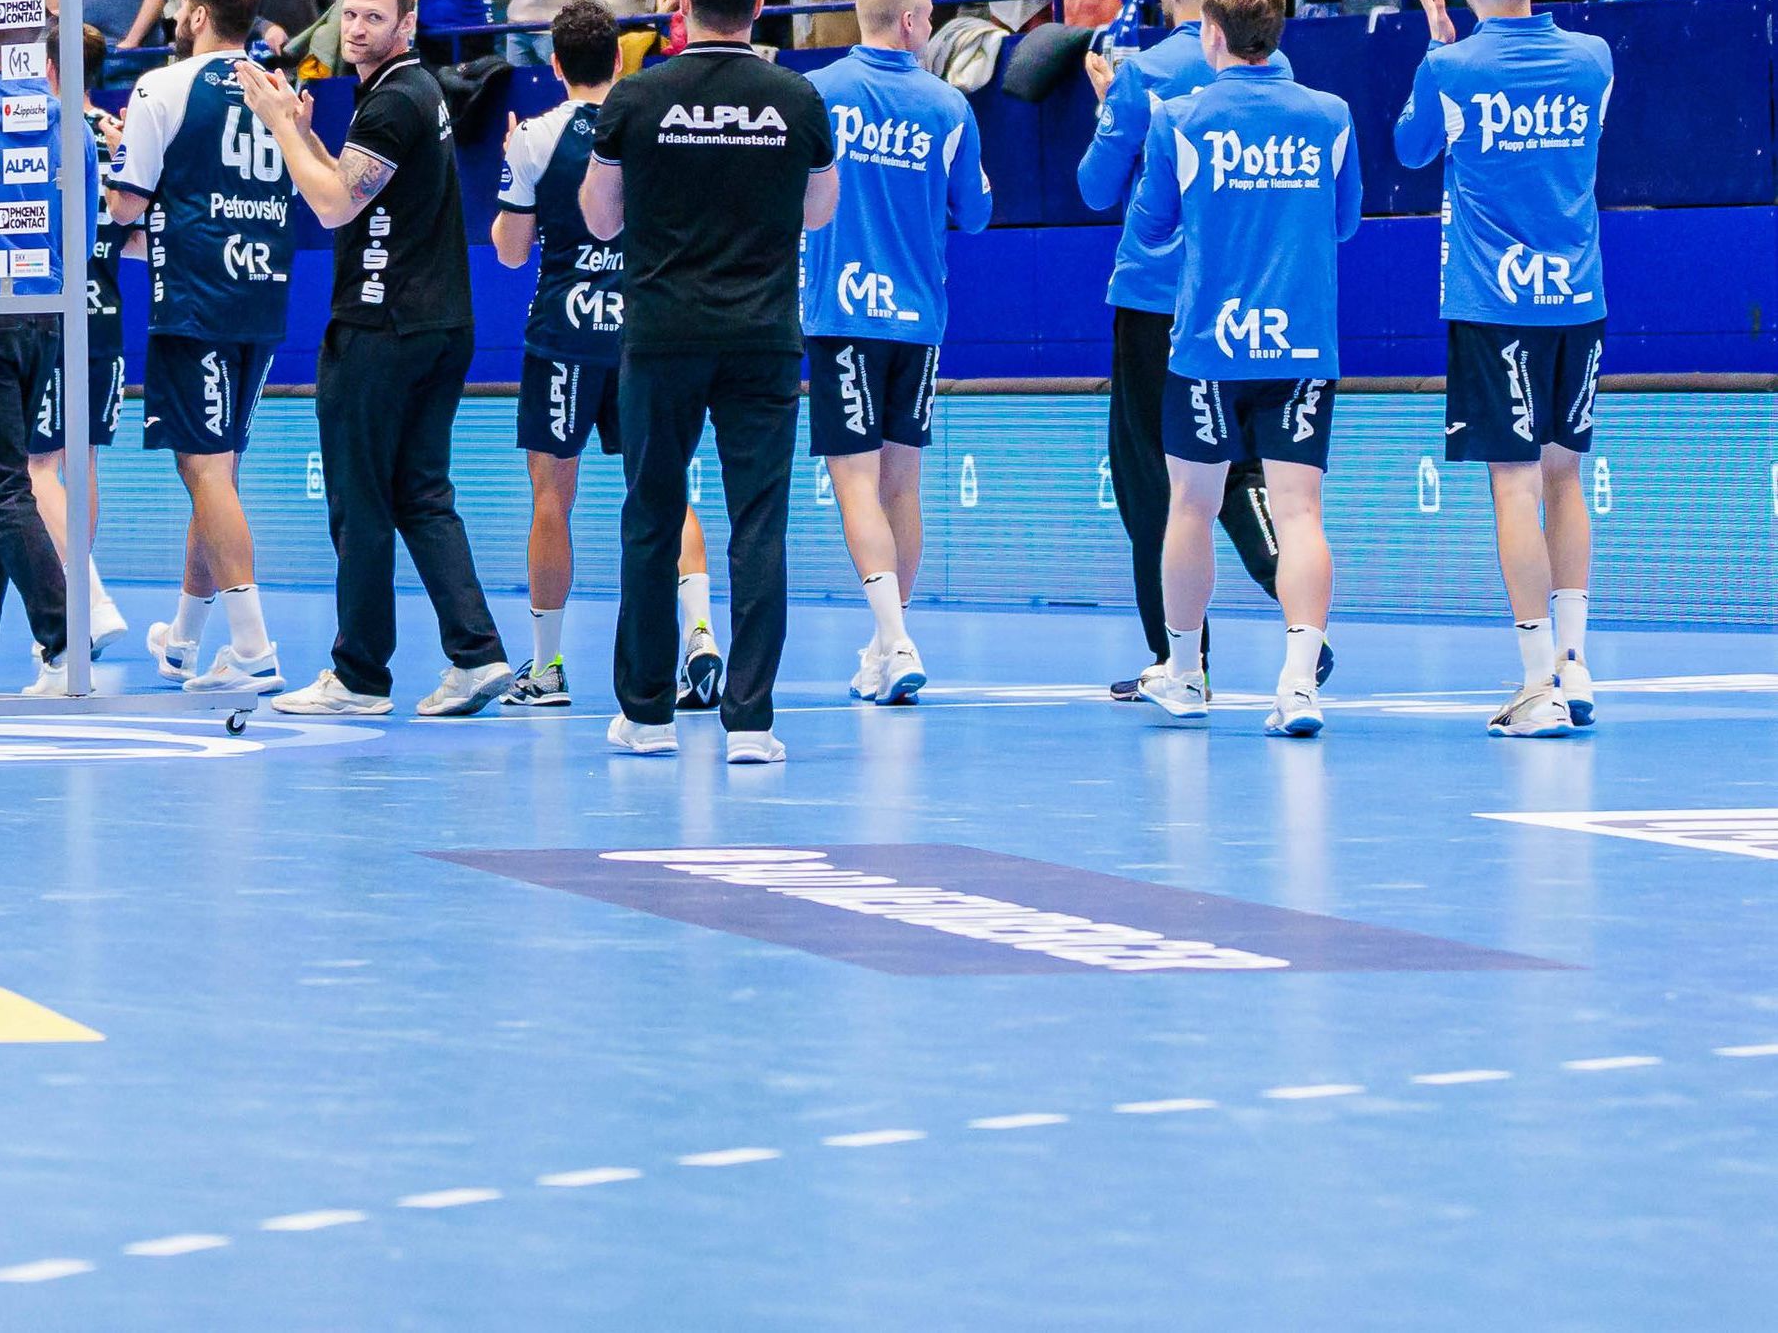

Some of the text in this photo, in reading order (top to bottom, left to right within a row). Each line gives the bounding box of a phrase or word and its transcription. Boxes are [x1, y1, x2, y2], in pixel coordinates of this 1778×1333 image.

[6, 11, 42, 24] CONTACT
[12, 103, 46, 118] Lippische
[660, 104, 788, 131] ALPLA
[1470, 91, 1590, 154] Pott's
[658, 133, 787, 146] #daskannkunststoff
[831, 104, 933, 161] Pott's
[5, 158, 46, 174] ALPLA
[1203, 129, 1321, 193] Pott's
[9, 217, 45, 229] CONTACT
[210, 192, 288, 227] Petrovský
[574, 244, 624, 272] Zehn
[201, 351, 223, 437] ALPLA
[836, 345, 867, 436] ALPLA
[1501, 339, 1533, 443] ALPLA
[1191, 379, 1218, 445] ALPL
